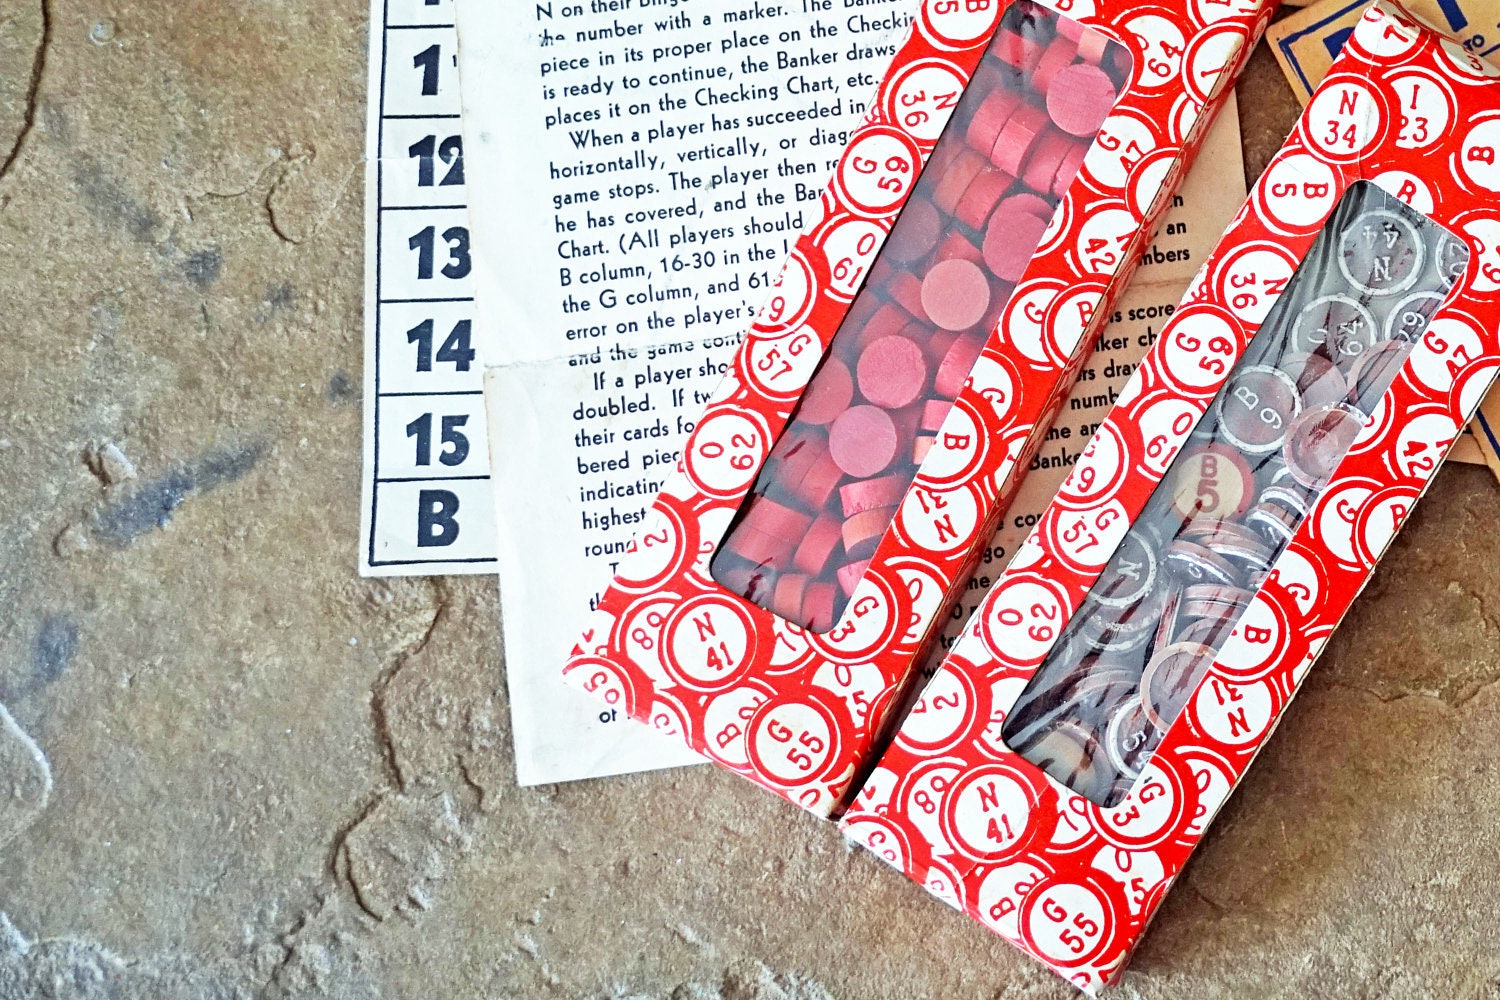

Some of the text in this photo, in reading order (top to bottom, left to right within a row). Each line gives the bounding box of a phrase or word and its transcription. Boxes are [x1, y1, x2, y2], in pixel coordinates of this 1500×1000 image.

[545, 72, 879, 130] places it on the Checking Chart, etc.
[408, 226, 472, 280] 13
[406, 319, 476, 372] 14
[406, 413, 470, 466] 15
[417, 489, 460, 547] B
[693, 612, 716, 642] N
[707, 642, 733, 671] 41
[767, 719, 793, 743] G
[786, 731, 824, 770] 55
[977, 782, 999, 812] N
[987, 814, 1014, 843] 41
